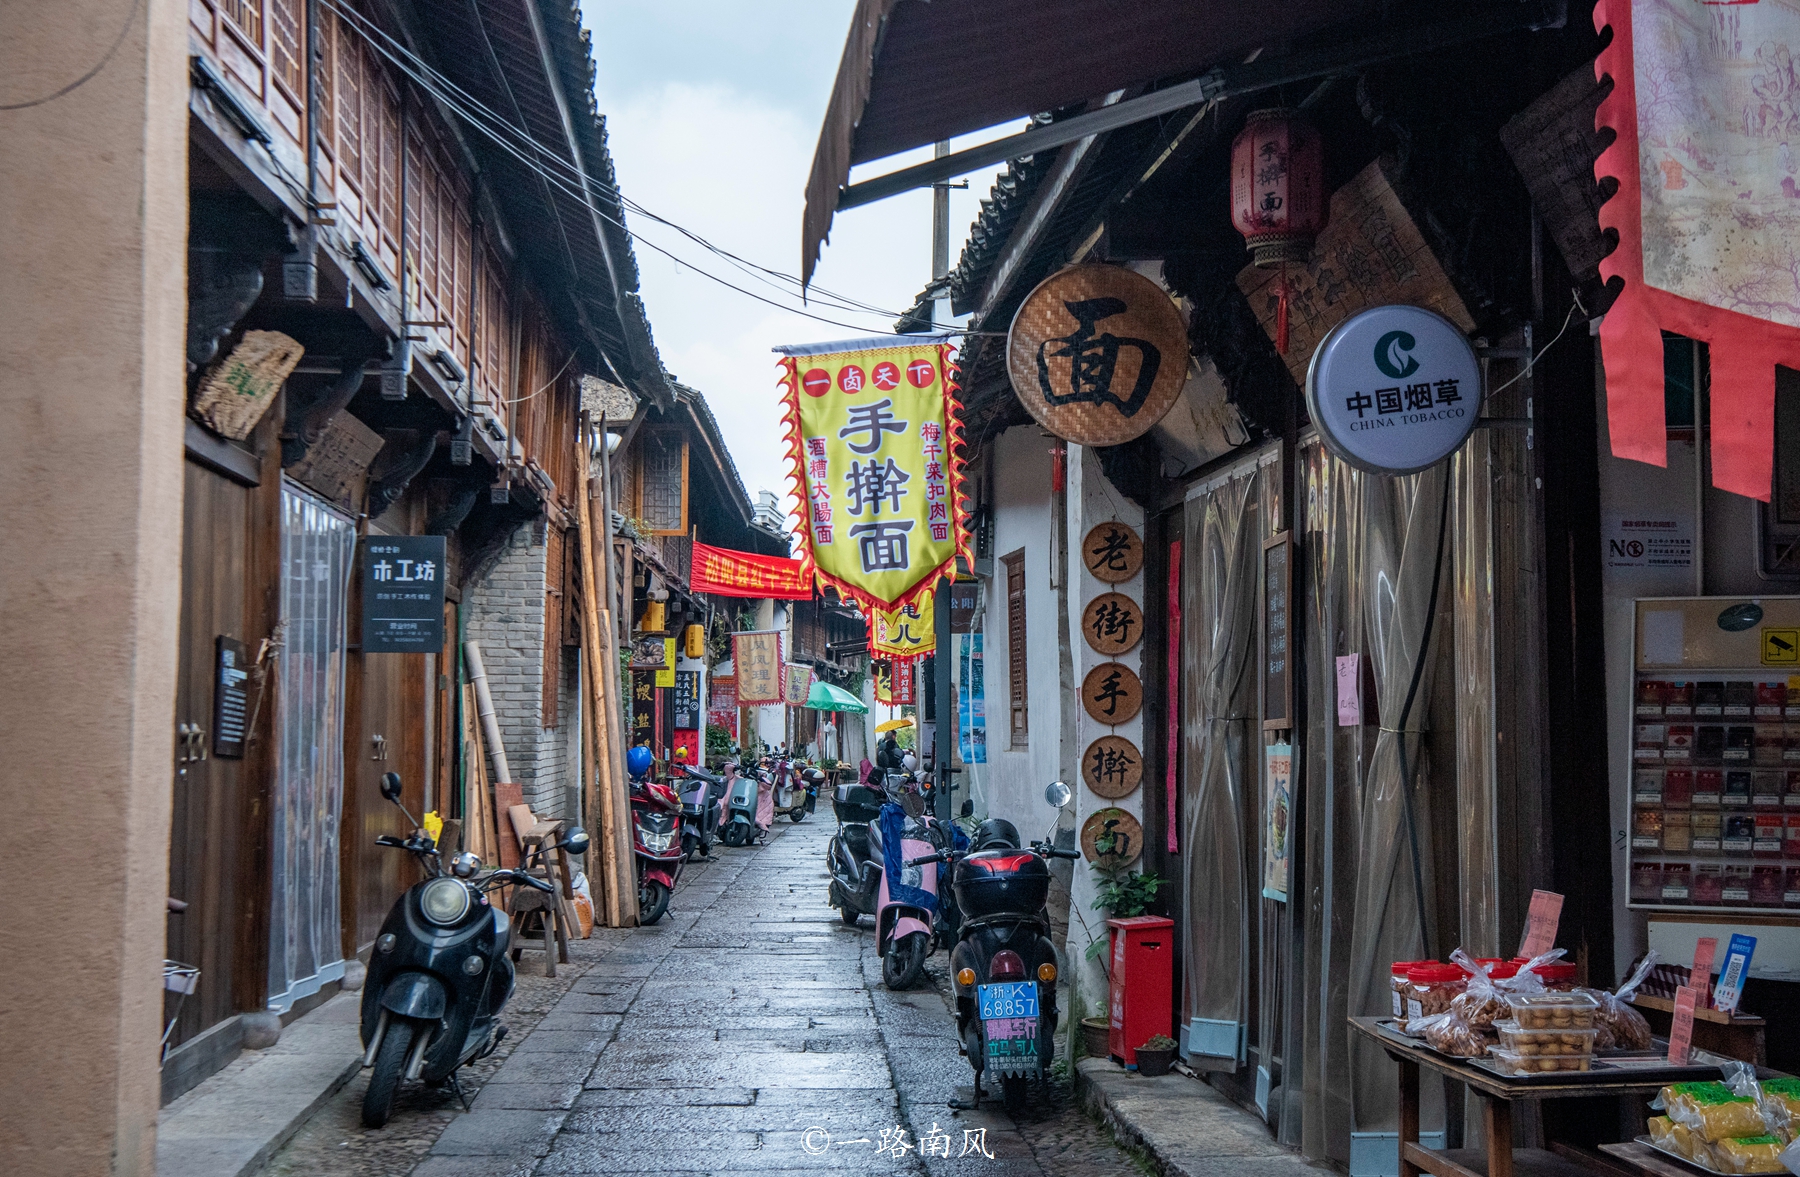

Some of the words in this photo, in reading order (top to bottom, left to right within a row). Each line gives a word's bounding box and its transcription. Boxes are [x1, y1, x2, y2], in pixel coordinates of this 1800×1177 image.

[805, 363, 932, 391] 一卤天下
[1036, 297, 1162, 419] 面
[1346, 379, 1462, 418] 中国烟草
[1350, 418, 1395, 432] CHINA
[1401, 408, 1465, 424] TOBACCO
[840, 399, 914, 572] 手擀面
[922, 423, 948, 541] 梅干菜扣肉面
[372, 559, 436, 582] 木工坊
[1091, 529, 1136, 858] 老街手擀面
[983, 999, 1035, 1017] 68857
